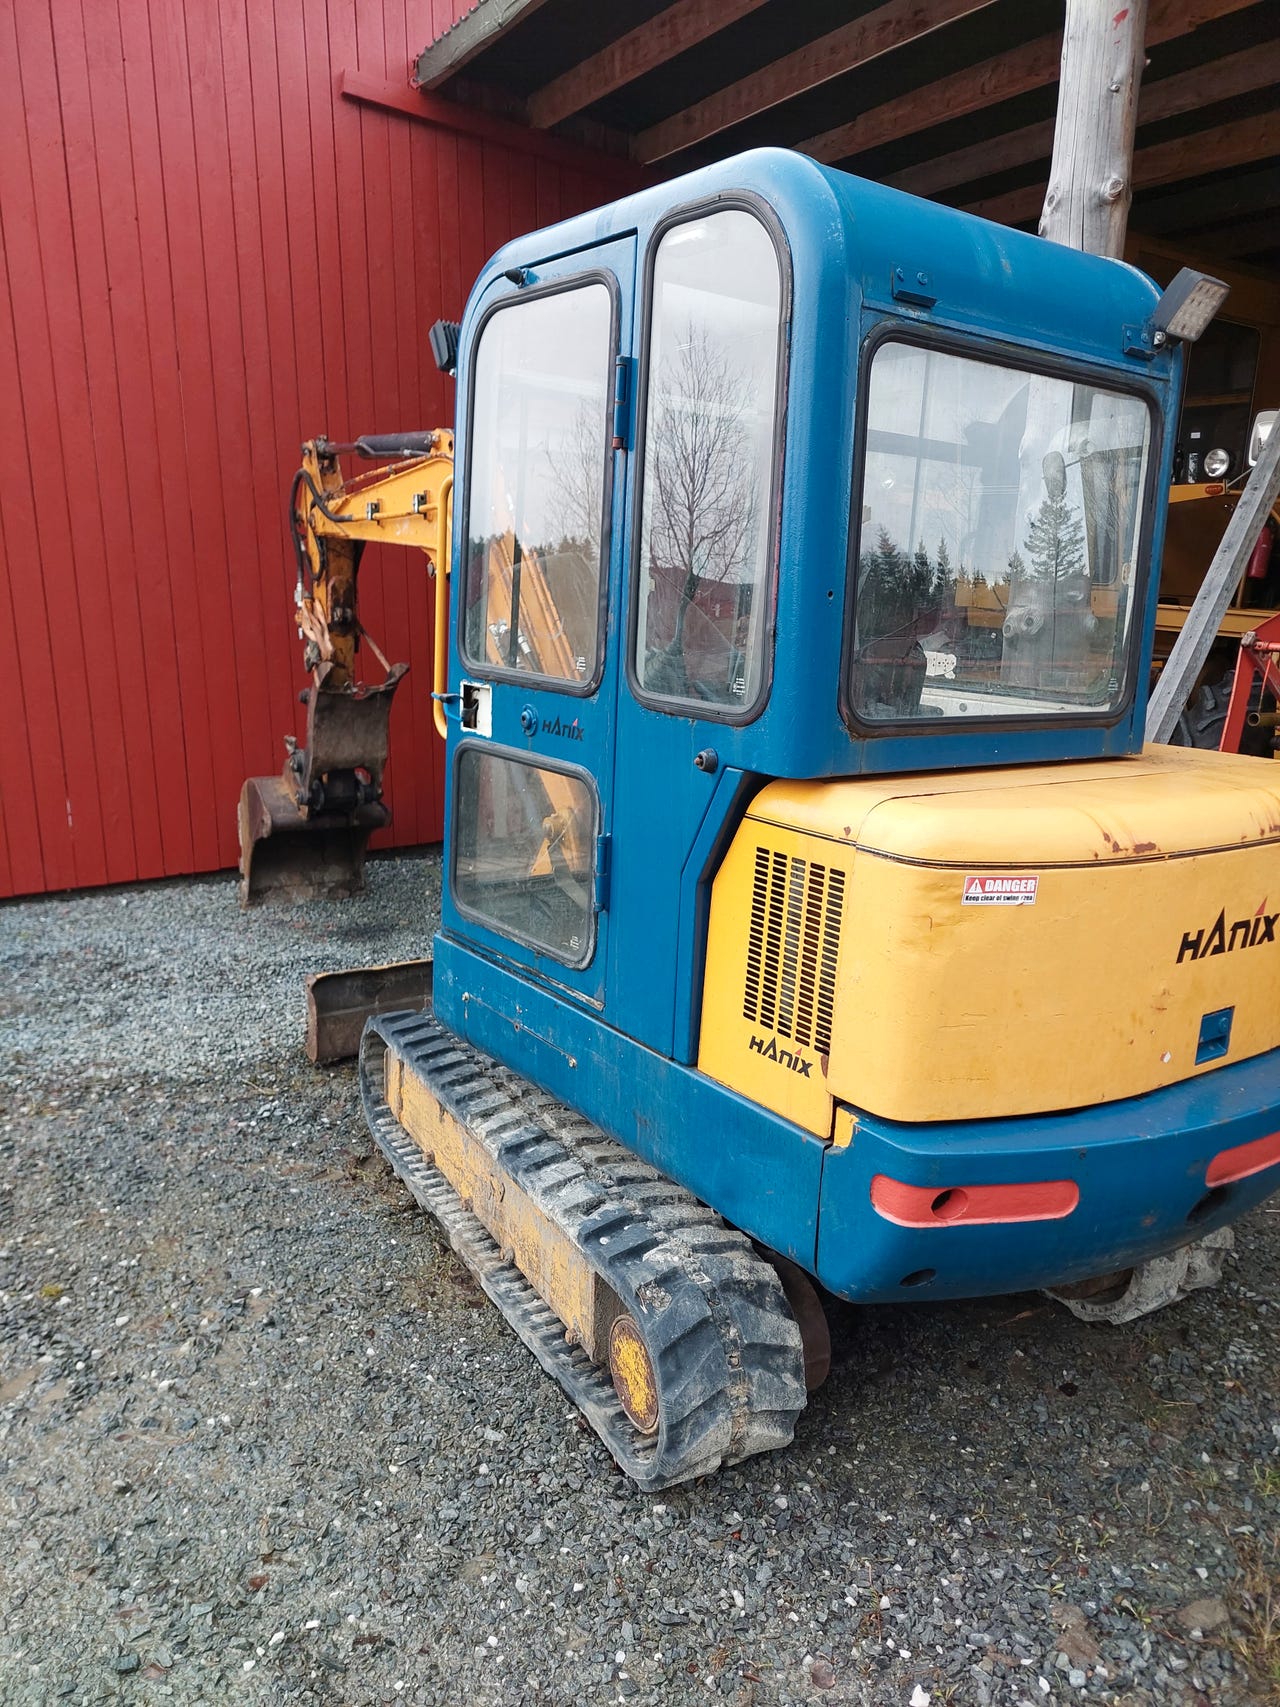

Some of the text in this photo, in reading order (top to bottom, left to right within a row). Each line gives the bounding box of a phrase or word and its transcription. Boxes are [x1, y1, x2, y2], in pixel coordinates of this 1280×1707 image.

[985, 879, 1035, 892] DANGER
[965, 894, 979, 902] Keep
[981, 894, 995, 902] clear
